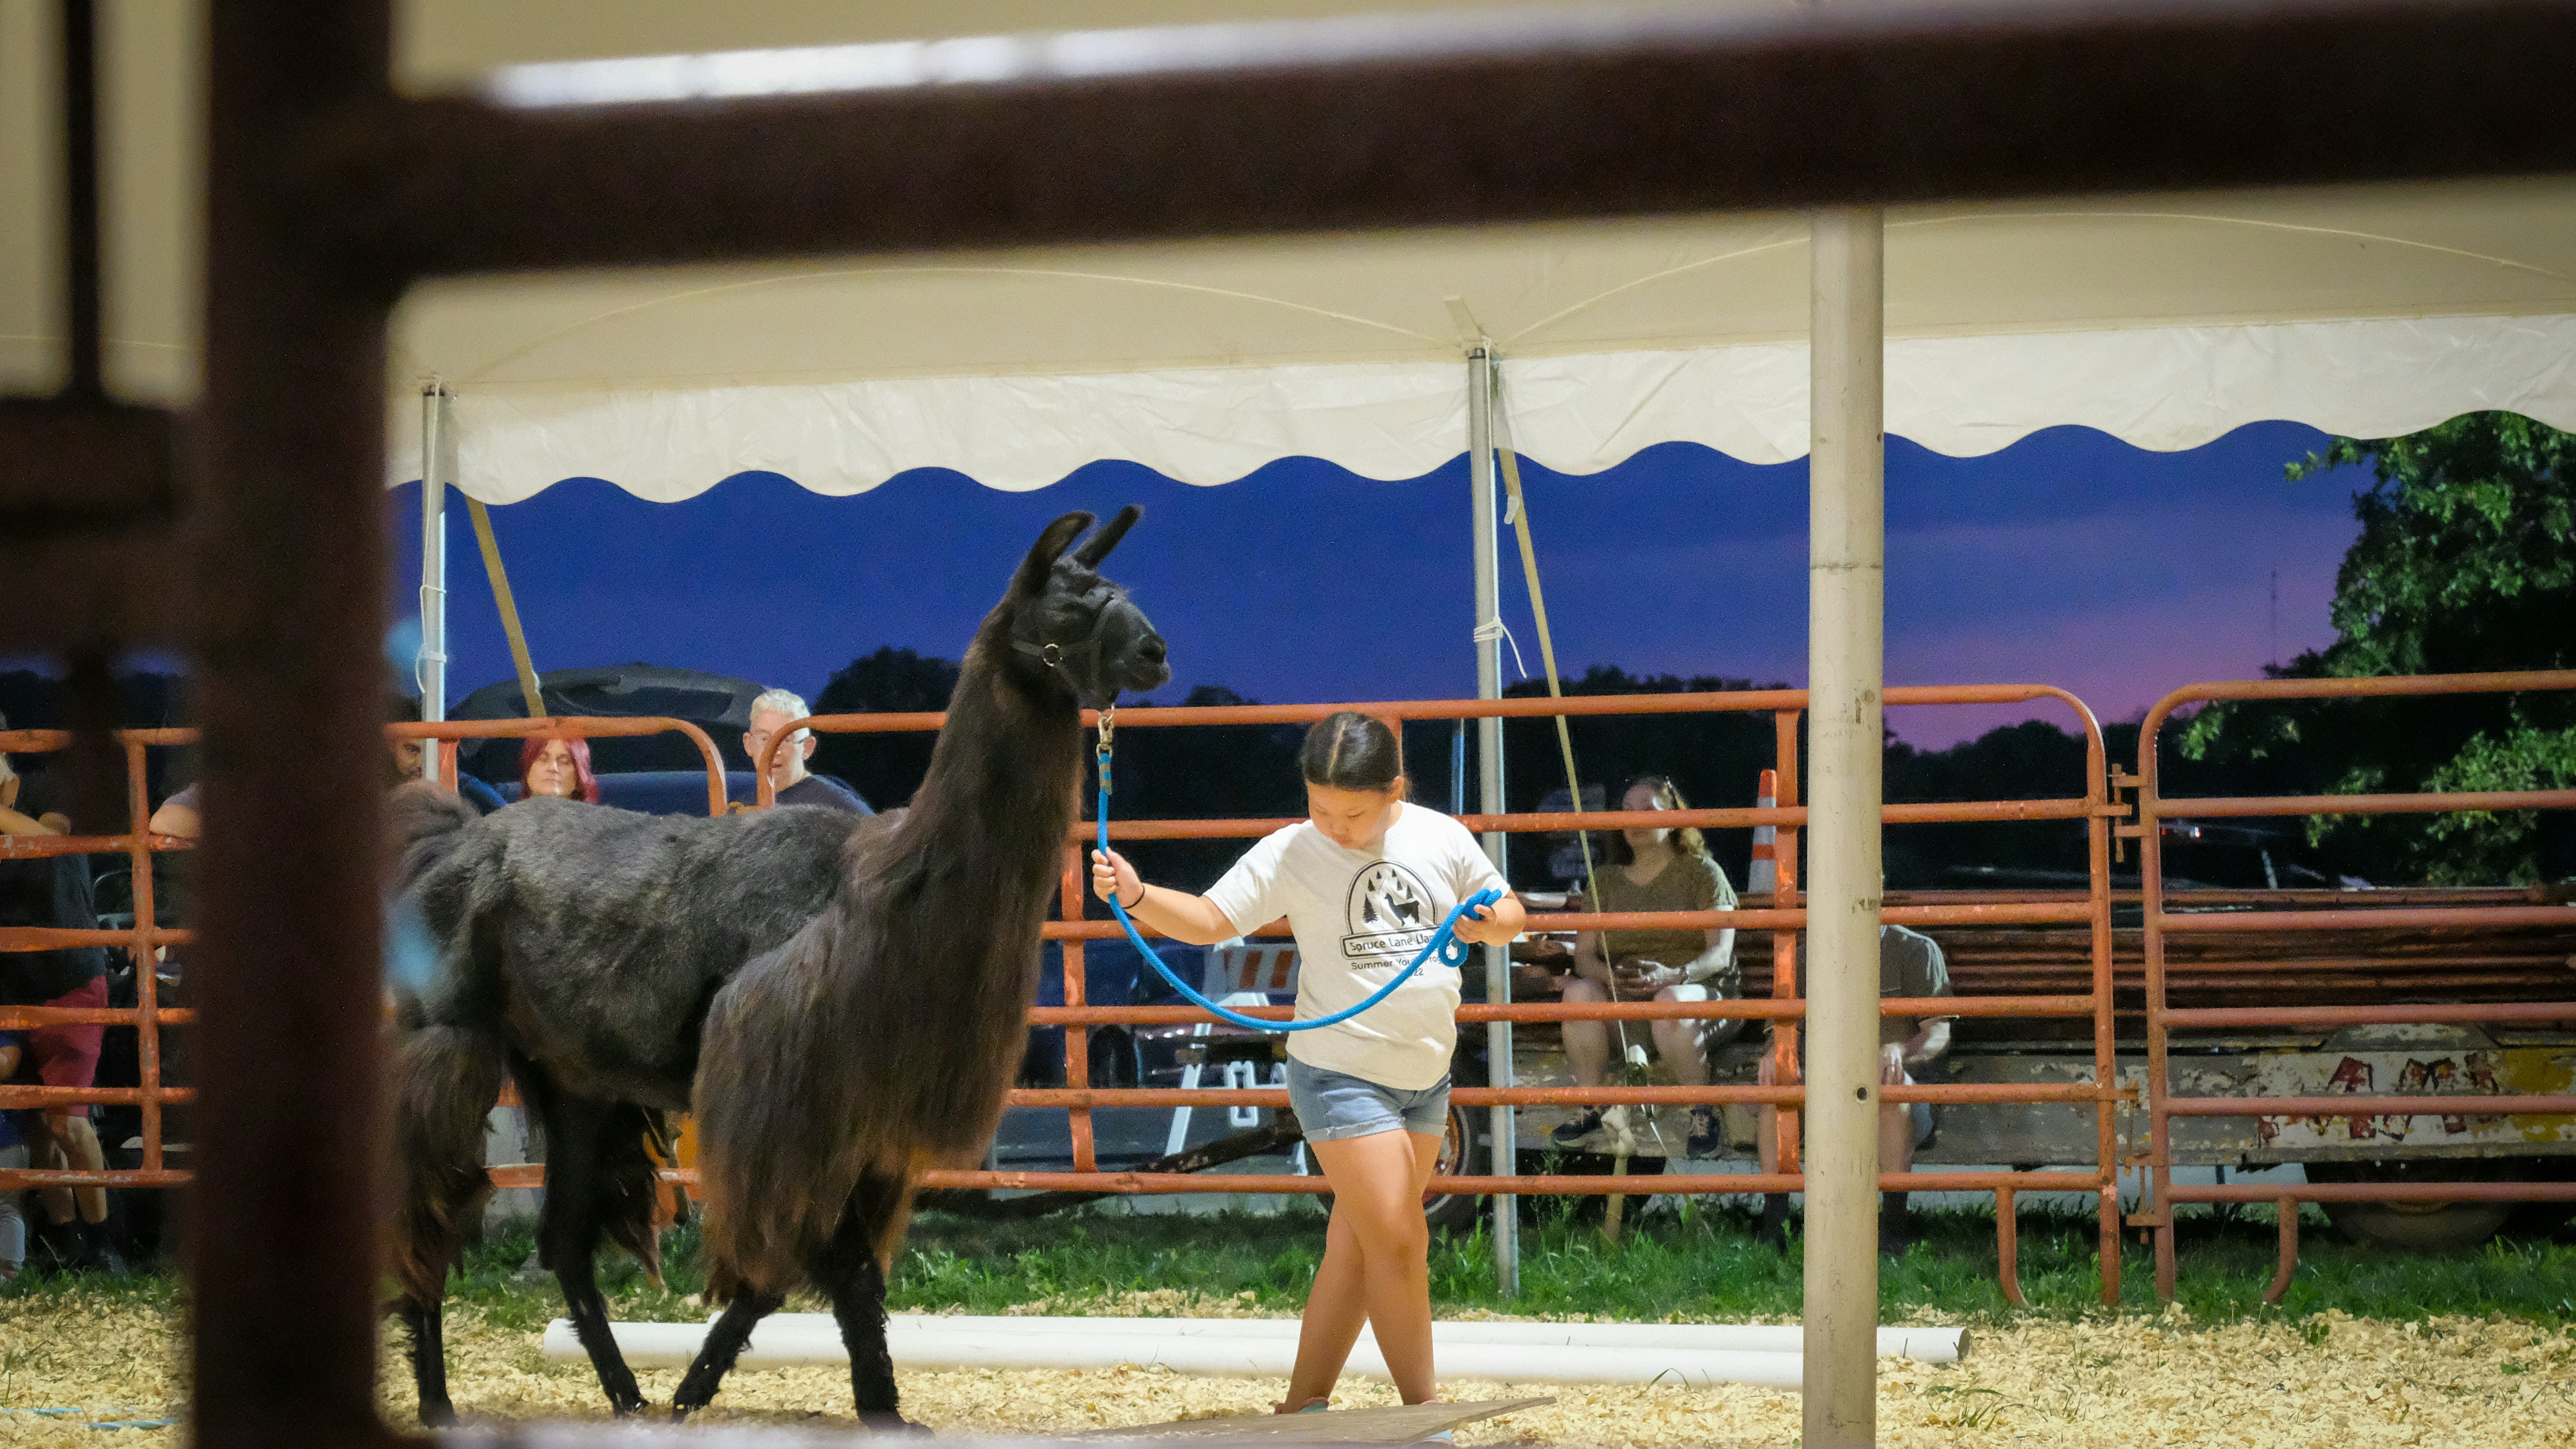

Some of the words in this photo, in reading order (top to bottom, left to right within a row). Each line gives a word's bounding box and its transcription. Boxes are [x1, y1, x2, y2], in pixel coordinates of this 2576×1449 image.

[1349, 941, 1386, 952] Spruce
[1388, 937, 1413, 947] Lane
[1351, 960, 1393, 970] Summer
